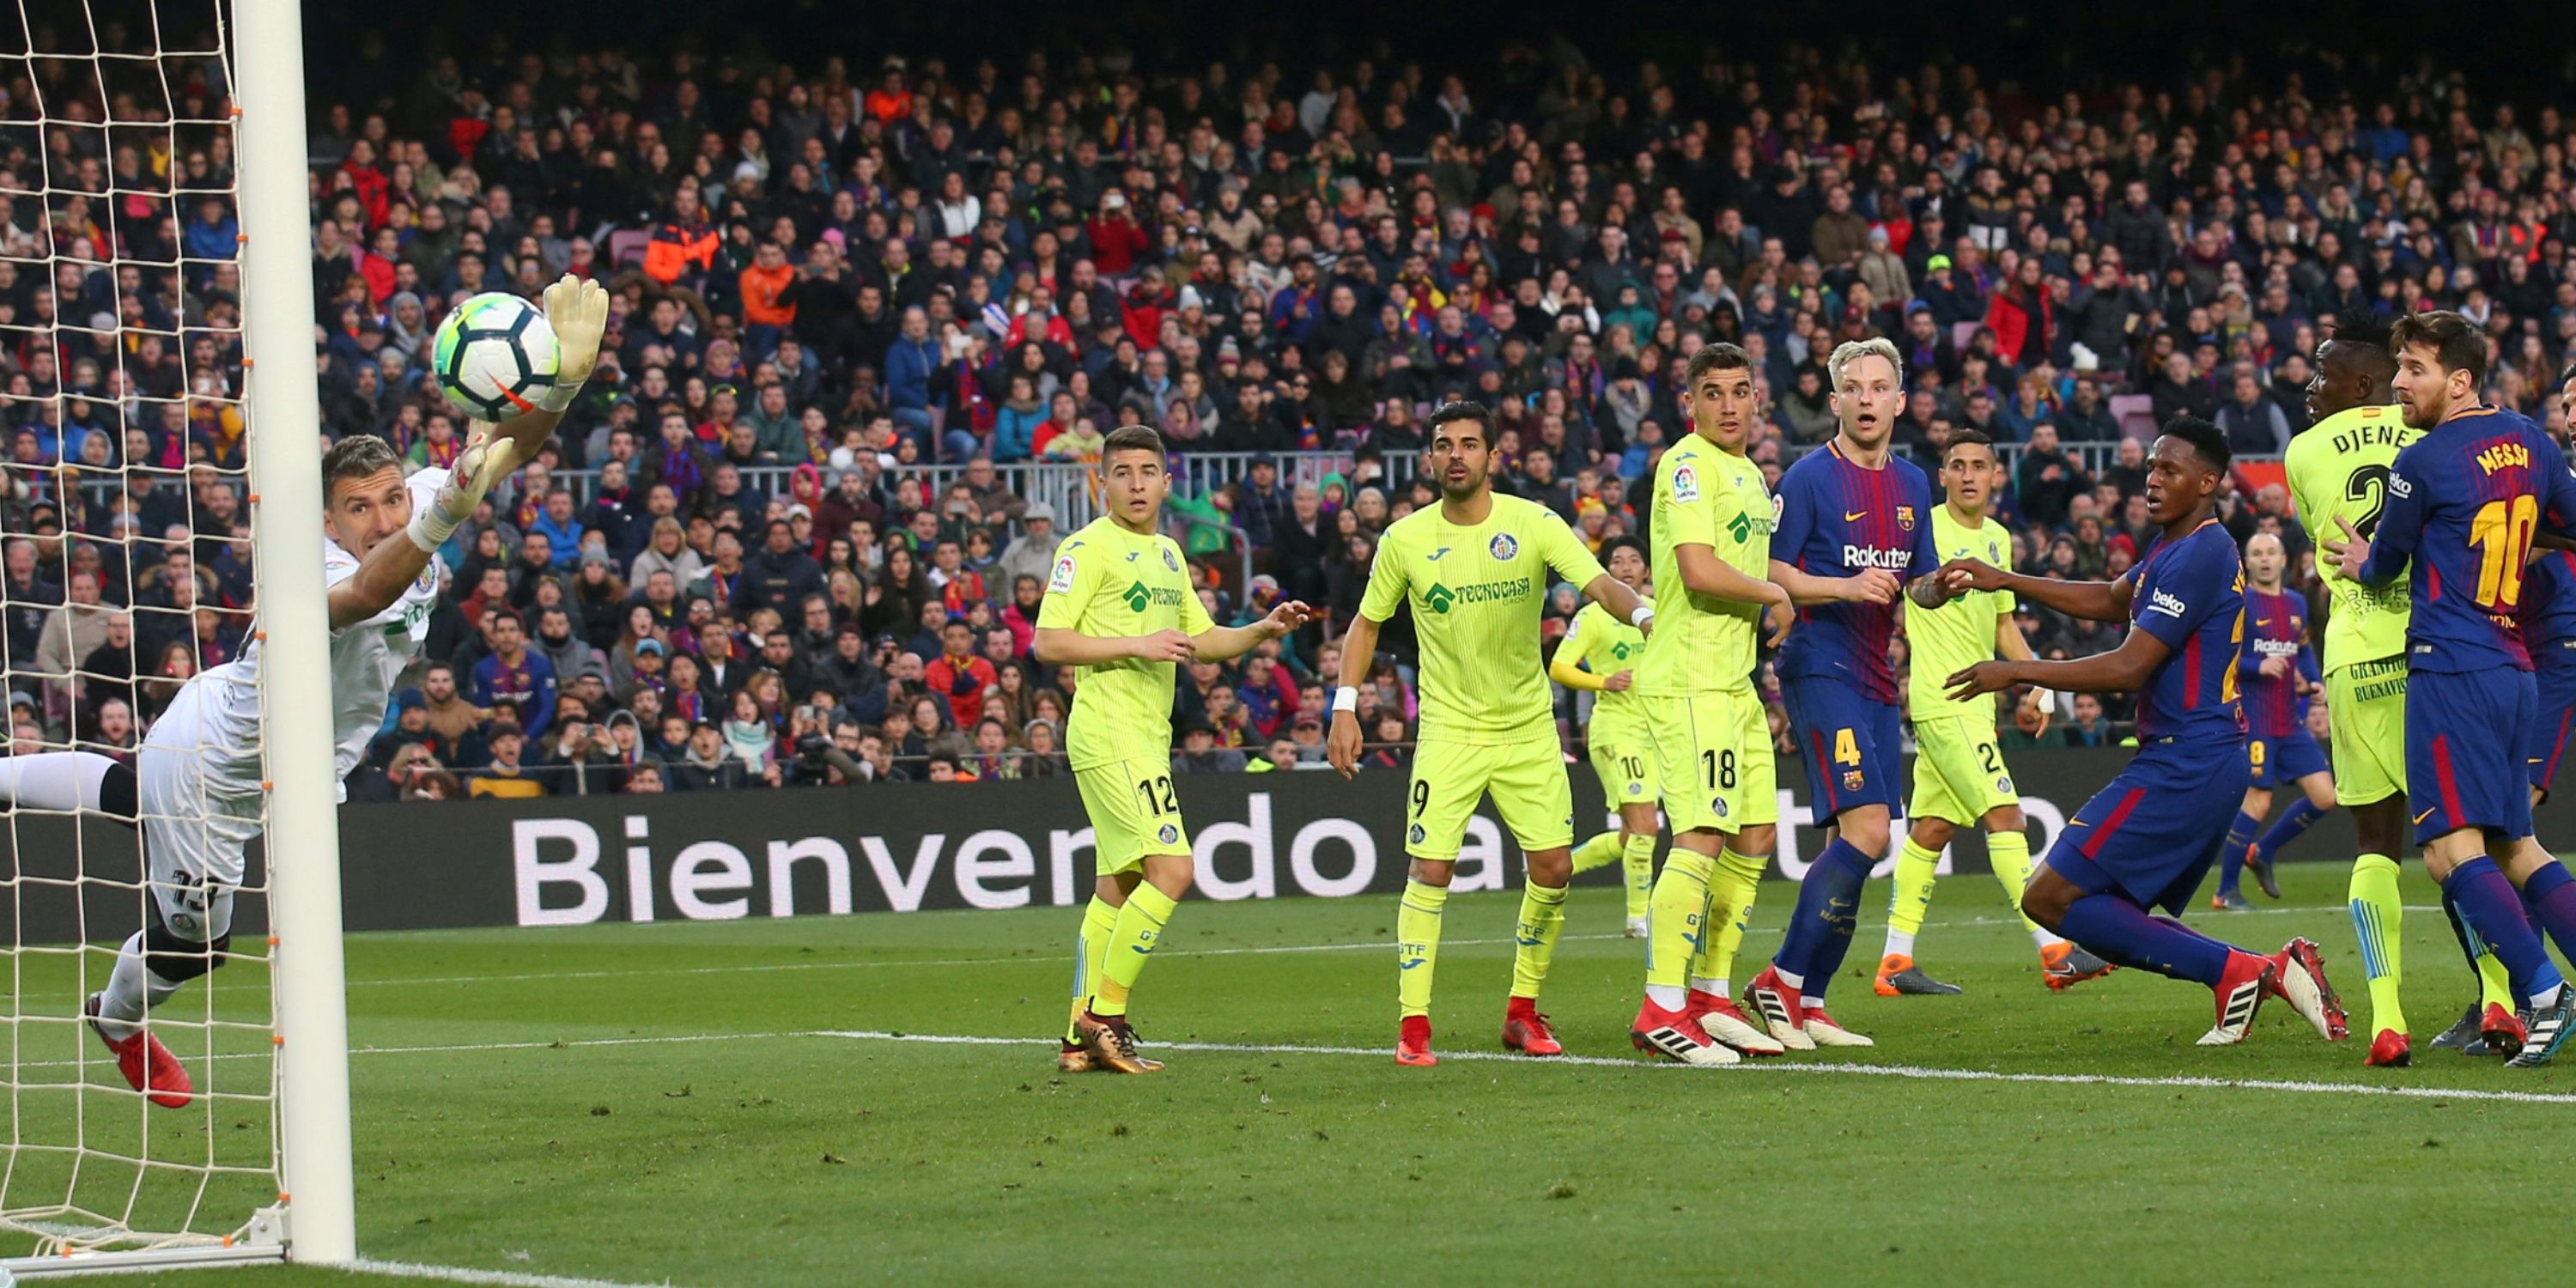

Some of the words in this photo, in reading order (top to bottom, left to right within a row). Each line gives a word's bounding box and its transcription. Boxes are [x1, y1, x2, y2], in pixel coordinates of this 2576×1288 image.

[2476, 442, 2529, 477] MESSI
[2389, 471, 2412, 495] eko
[2469, 494, 2538, 608] 10
[1455, 576, 1530, 605] TECNOCASA
[2152, 586, 2186, 614] beko
[1834, 727, 1862, 767] 4
[1977, 742, 2001, 775] 2
[2250, 740, 2265, 765] 8
[1620, 756, 1645, 780] 10
[1701, 749, 1736, 791] 18
[1138, 775, 1178, 818] 12
[513, 788, 1378, 927] Bienvendo
